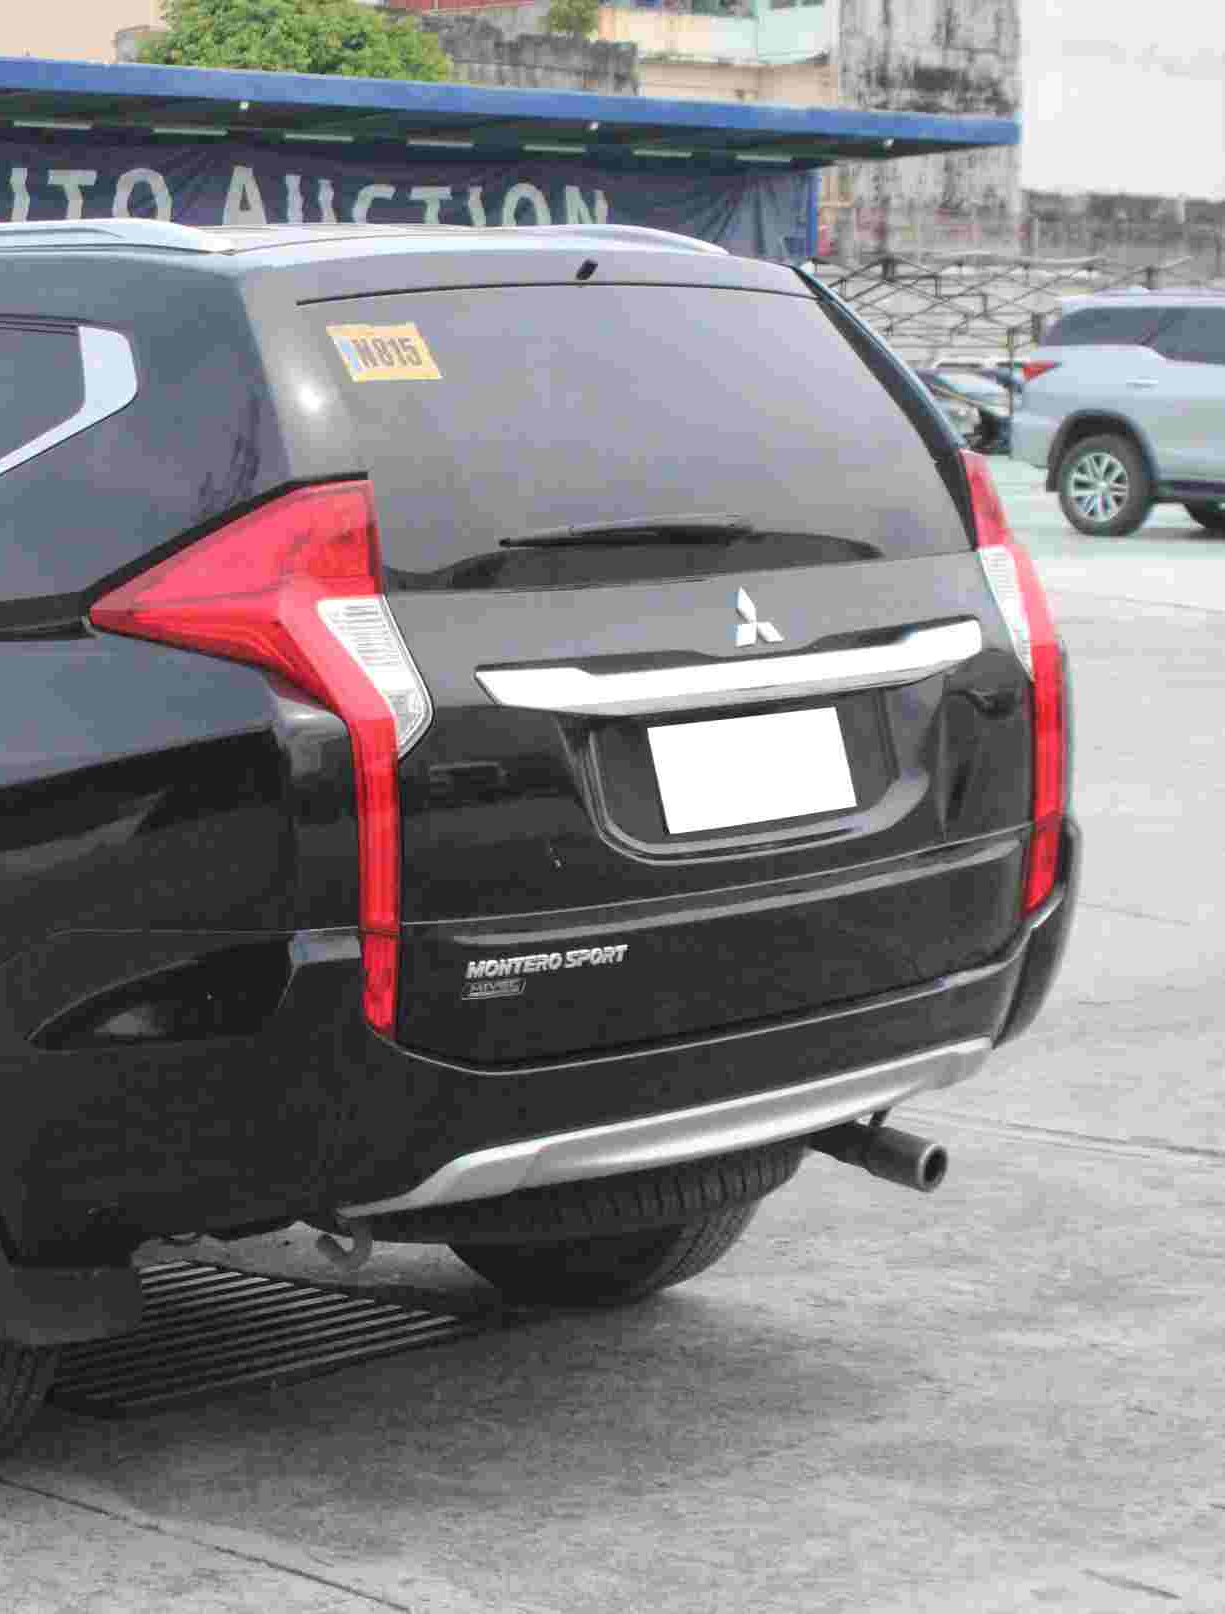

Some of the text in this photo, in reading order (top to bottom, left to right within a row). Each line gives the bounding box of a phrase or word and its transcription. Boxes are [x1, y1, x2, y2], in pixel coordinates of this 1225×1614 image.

[222, 166, 609, 227] AUCTION
[465, 944, 630, 979] MONTERO SPORT
